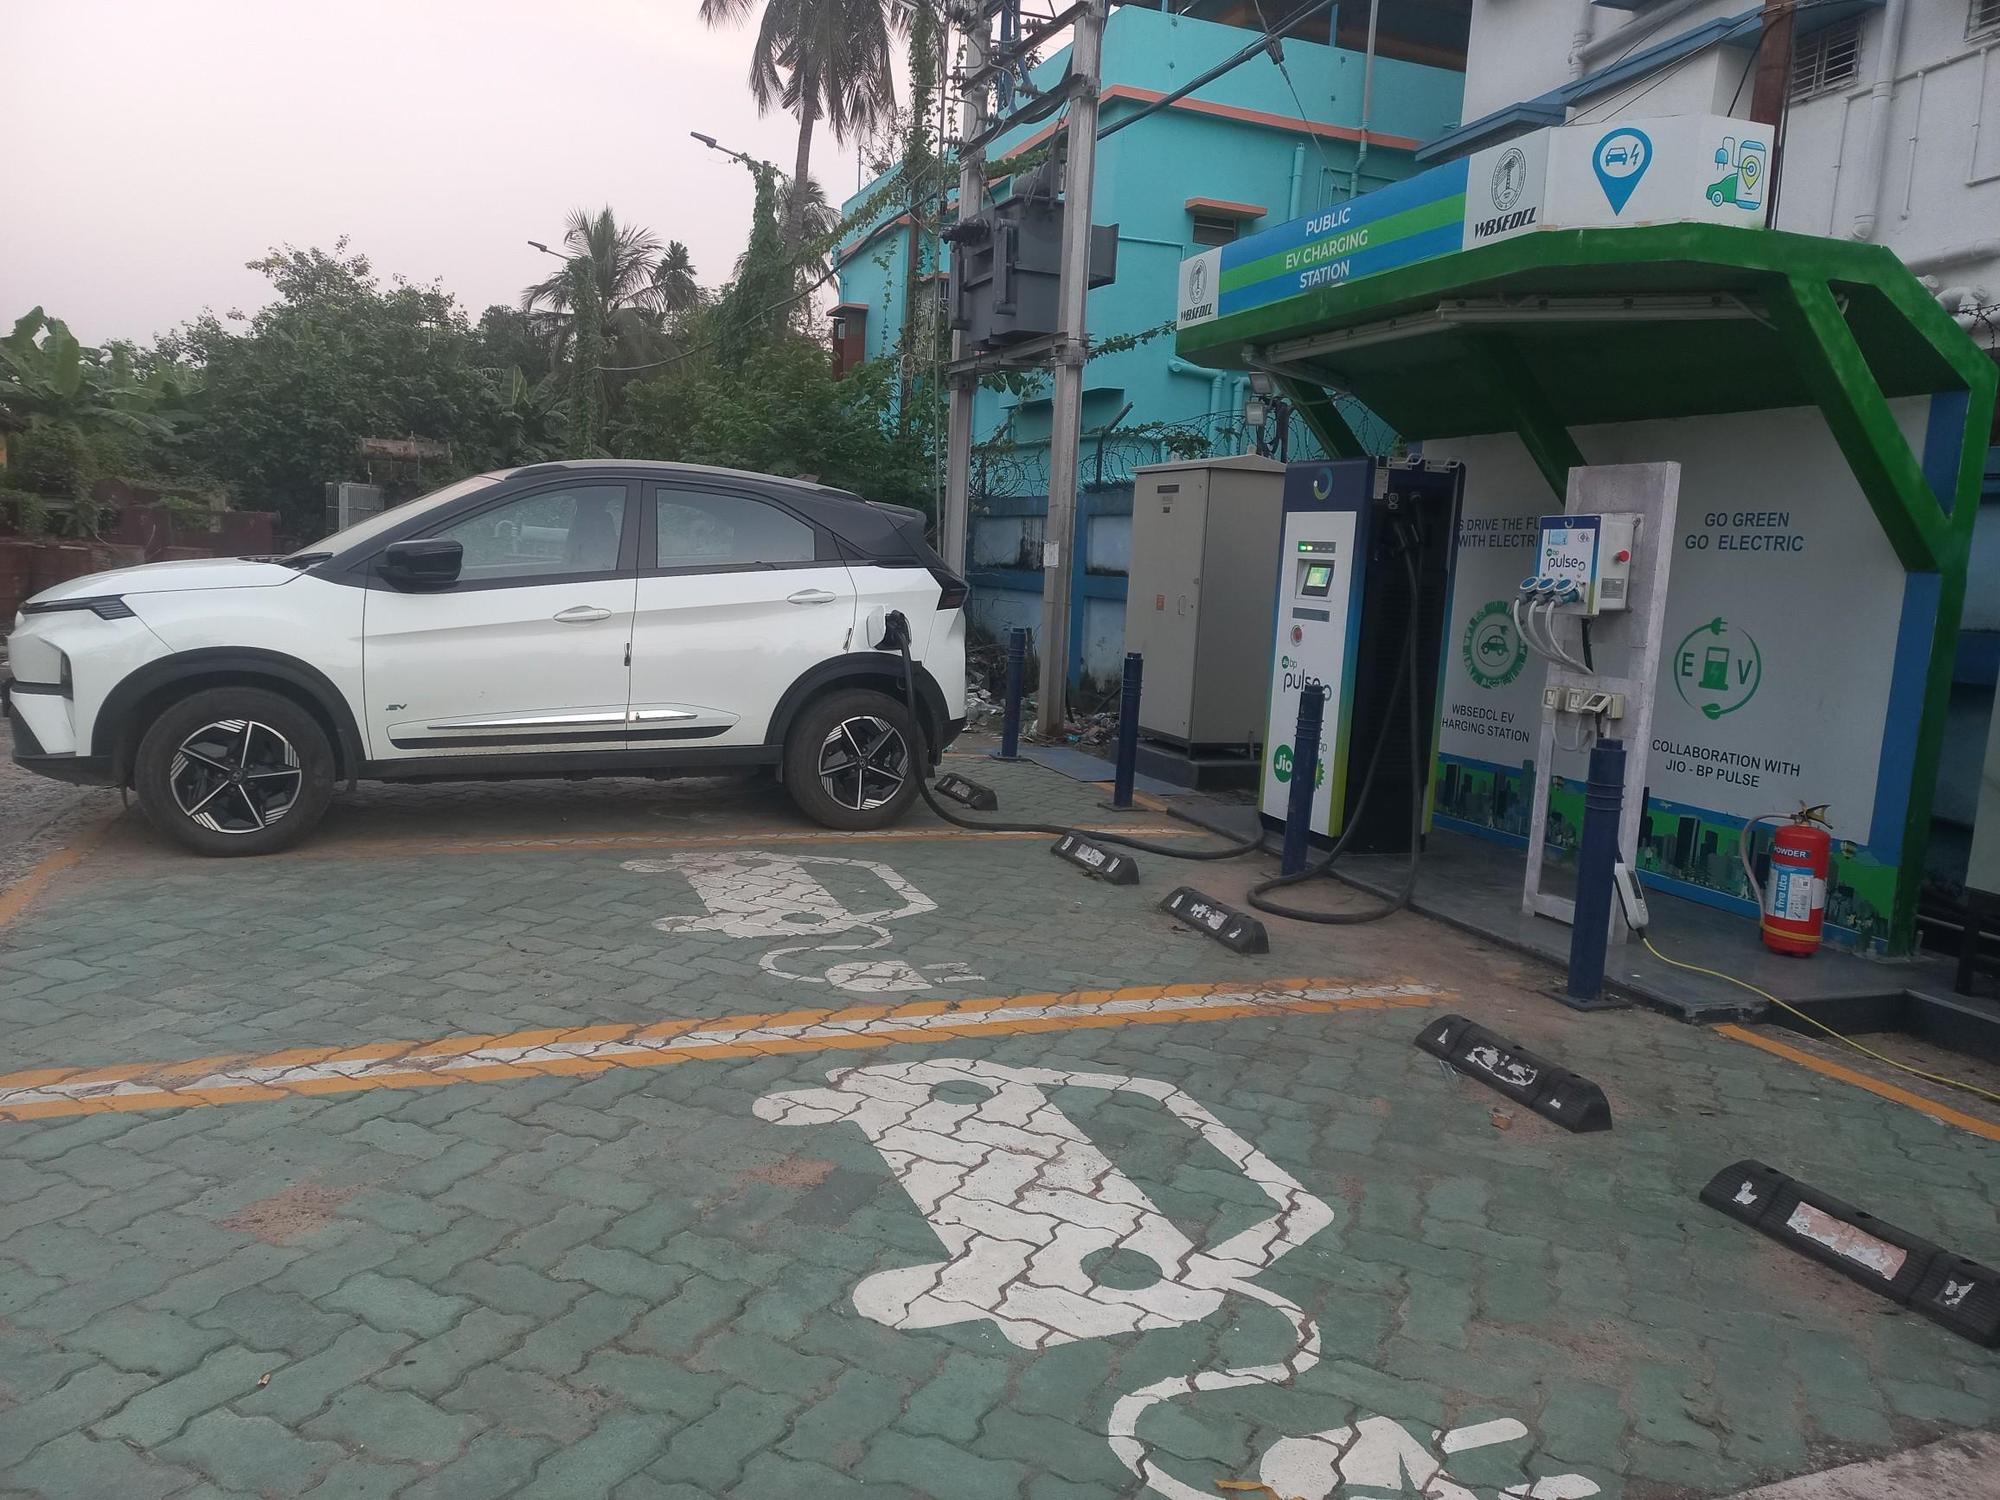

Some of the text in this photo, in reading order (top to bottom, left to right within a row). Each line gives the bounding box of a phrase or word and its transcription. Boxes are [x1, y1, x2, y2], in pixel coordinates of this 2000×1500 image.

[1305, 207, 1352, 237] PUBLIC
[1474, 206, 1537, 240] WBSEDCL
[1285, 229, 1369, 269] EV CHARGING
[1299, 259, 1350, 289] STATION
[1180, 302, 1213, 322] WBSEDCL
[1467, 518, 1499, 532] DRIVE
[1502, 517, 1523, 531] THE
[1704, 511, 1790, 528] GO GREEN
[1685, 534, 1804, 552] GO ELECTRIC
[1548, 554, 1579, 572] pulse
[1681, 652, 1753, 685] E V
[1452, 703, 1516, 725] WBSEDCL EV
[1487, 725, 1530, 743] STATION
[1275, 753, 1293, 773] Jio
[1652, 739, 1801, 777] COLLABORATION WITH
[1665, 759, 1687, 774] JIO
[1696, 764, 1714, 778] BP
[1716, 768, 1760, 788] PULSE
